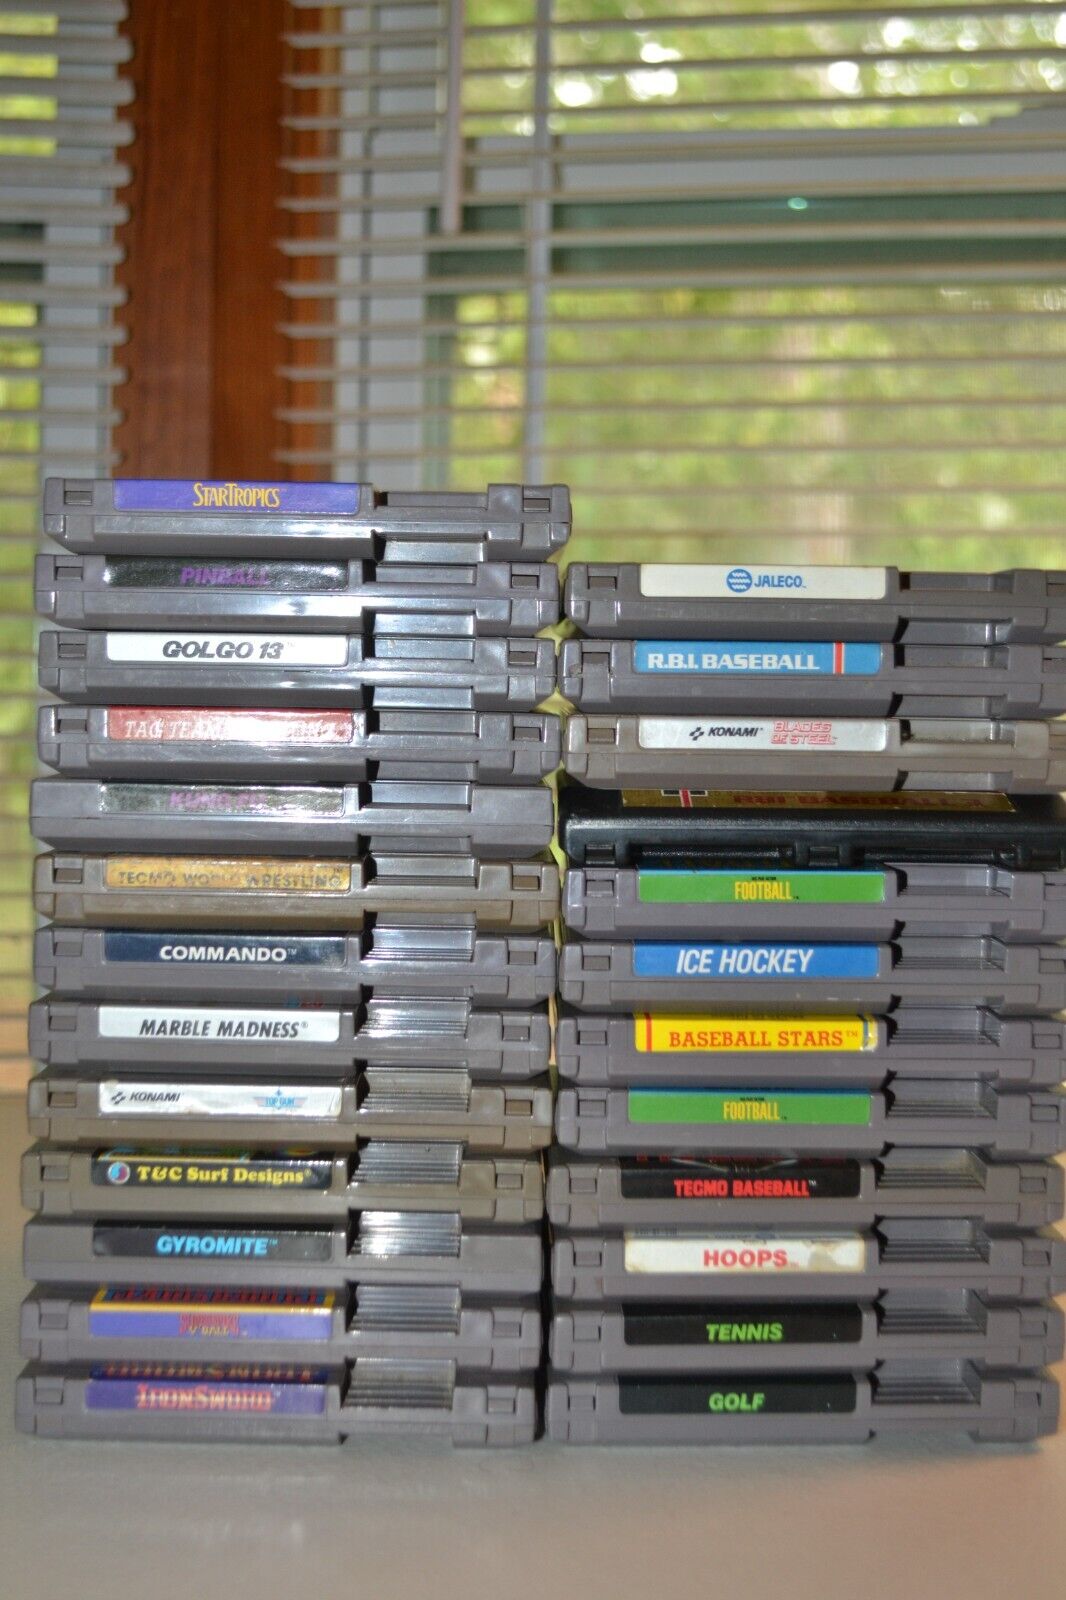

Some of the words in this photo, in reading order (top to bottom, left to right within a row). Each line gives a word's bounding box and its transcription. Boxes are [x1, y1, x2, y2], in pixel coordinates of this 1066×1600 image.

[754, 574, 803, 588] JALECO
[162, 640, 254, 659] GOLGO
[258, 642, 285, 660] 13
[702, 653, 820, 670] BASEBALL
[125, 718, 163, 739] TAG
[707, 726, 759, 738] KONAMI
[735, 881, 792, 900] FOOTBALL
[159, 945, 287, 962] COMMANDO
[676, 949, 712, 974] ICE
[719, 949, 814, 974] HOCKEY
[139, 1018, 211, 1036] MARBLE
[216, 1021, 300, 1038] MADNESS
[669, 1031, 771, 1048] BASEBALL
[777, 1031, 843, 1047] STARS
[129, 1091, 181, 1102] KONAMI
[723, 1101, 780, 1120] FOOTBALL
[137, 1165, 182, 1181] T&C
[187, 1166, 228, 1182] Surf
[233, 1166, 304, 1185] Designs
[674, 1179, 728, 1197] TECMO
[732, 1179, 809, 1198] BASEBALL
[156, 1235, 268, 1255] GYROMITE
[703, 1249, 788, 1268] HOOPS
[706, 1323, 783, 1342] TENNIS
[708, 1392, 765, 1412] GOLF
